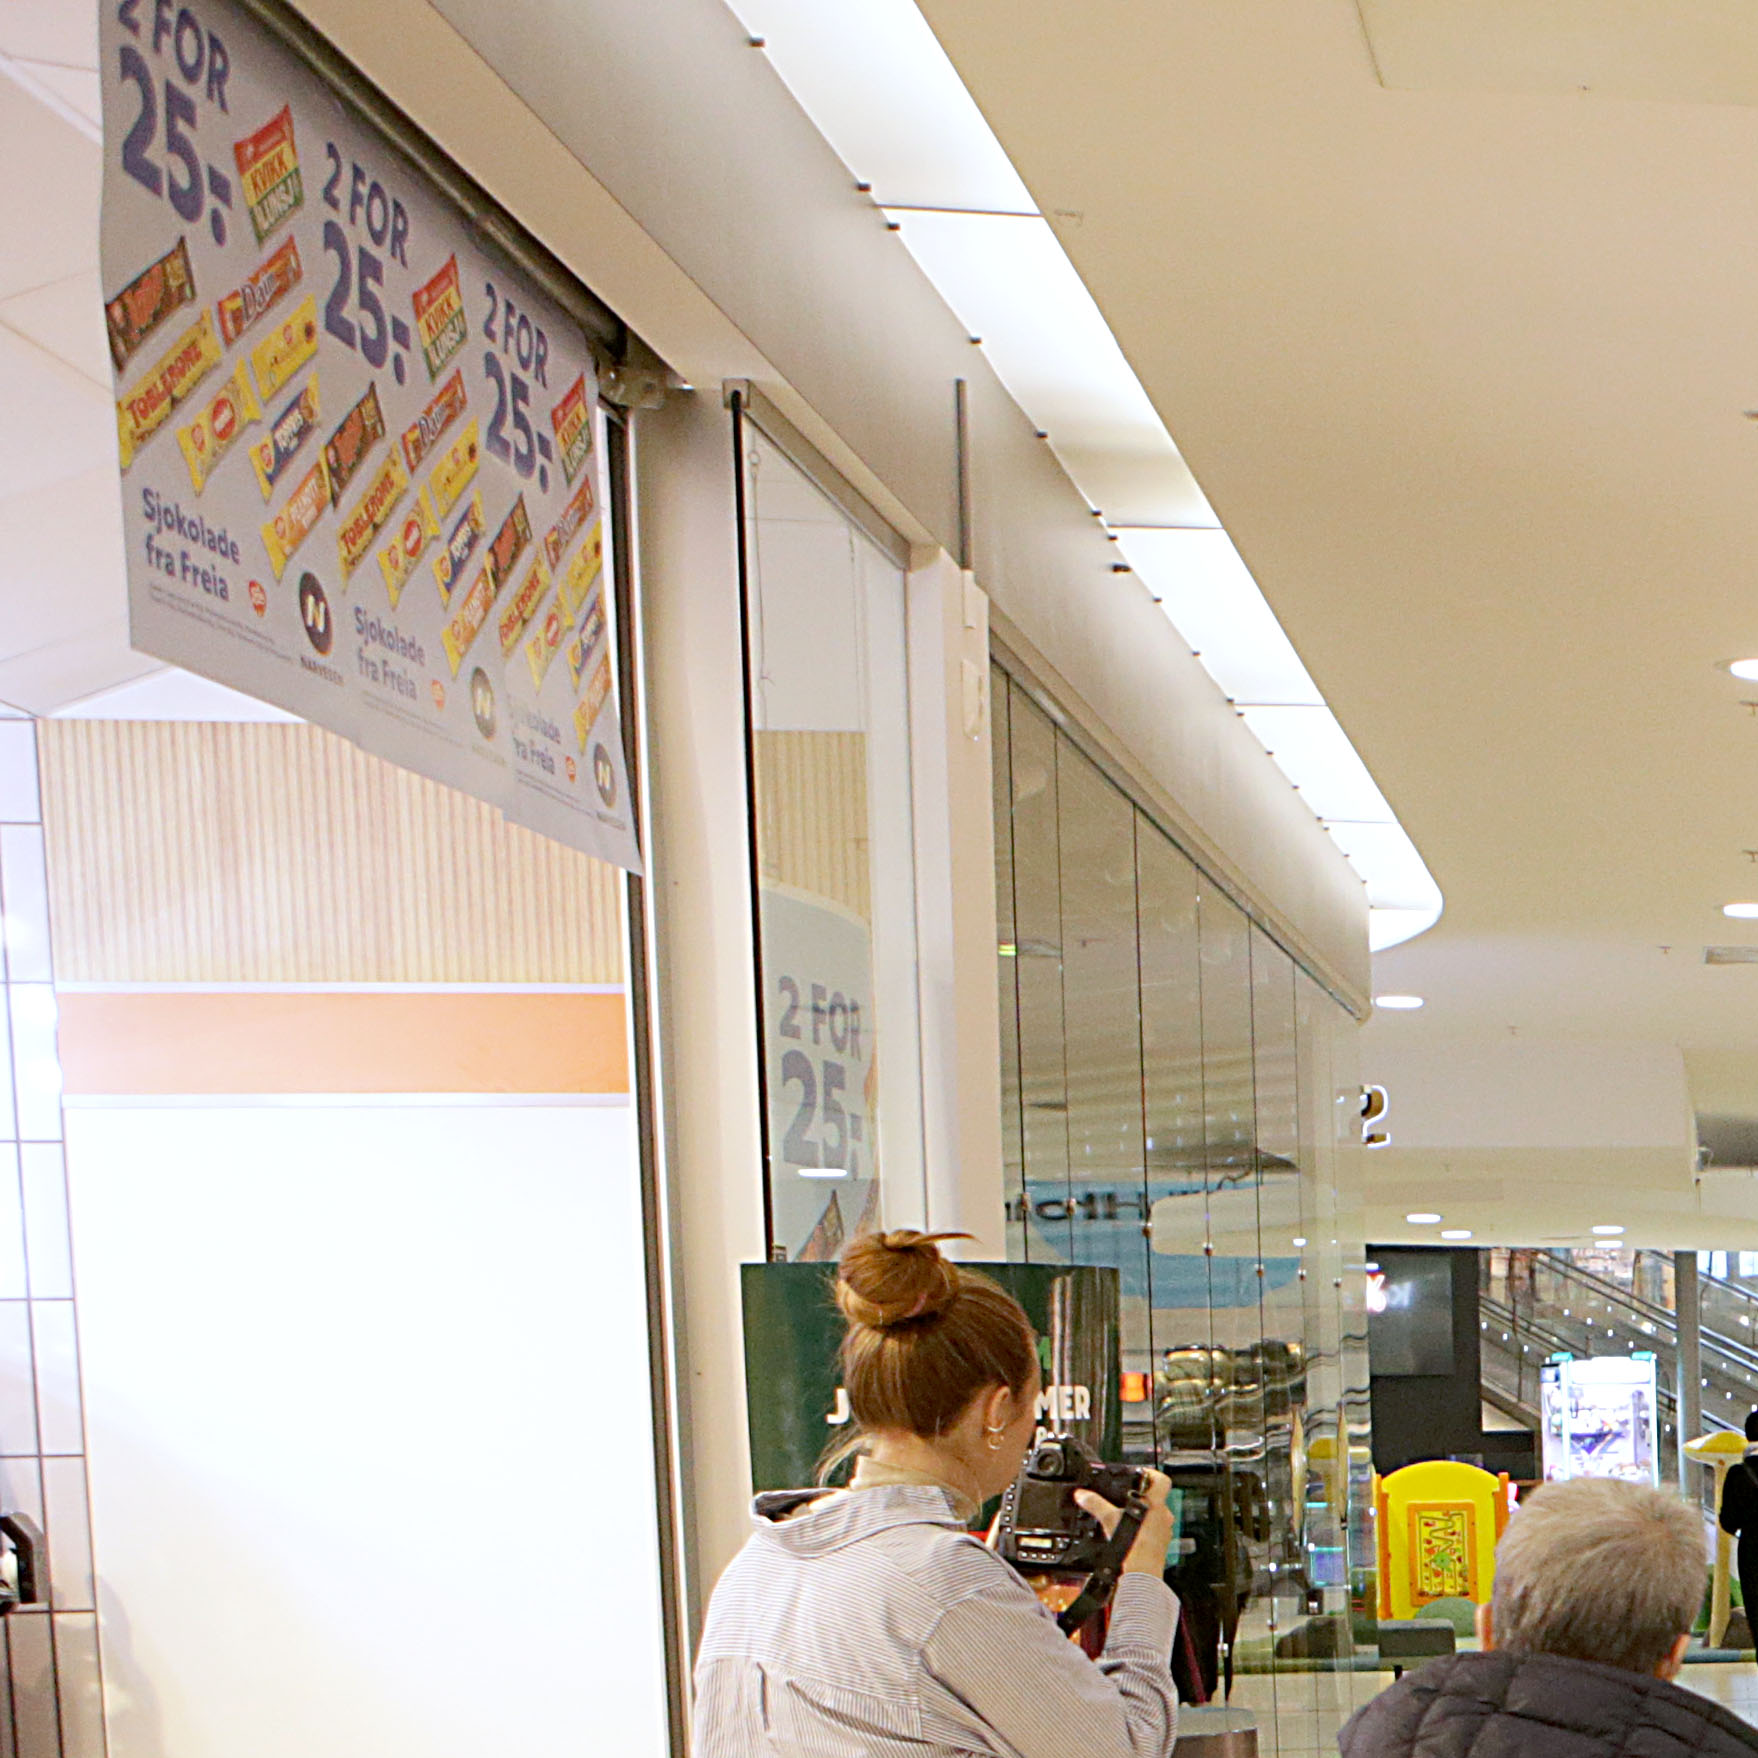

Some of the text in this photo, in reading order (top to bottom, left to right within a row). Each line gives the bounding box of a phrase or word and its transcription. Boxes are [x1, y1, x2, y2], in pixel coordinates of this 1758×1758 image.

[322, 141, 410, 270] 2 FOR
[483, 282, 549, 390] 2 FOR
[142, 487, 240, 566] Sjokolade
[145, 532, 176, 578] fra
[180, 549, 230, 602] Freia
[354, 606, 426, 668] Sjokolade
[358, 647, 379, 682] fra
[381, 659, 418, 701] Freia
[778, 975, 862, 1063] 2 FOR
